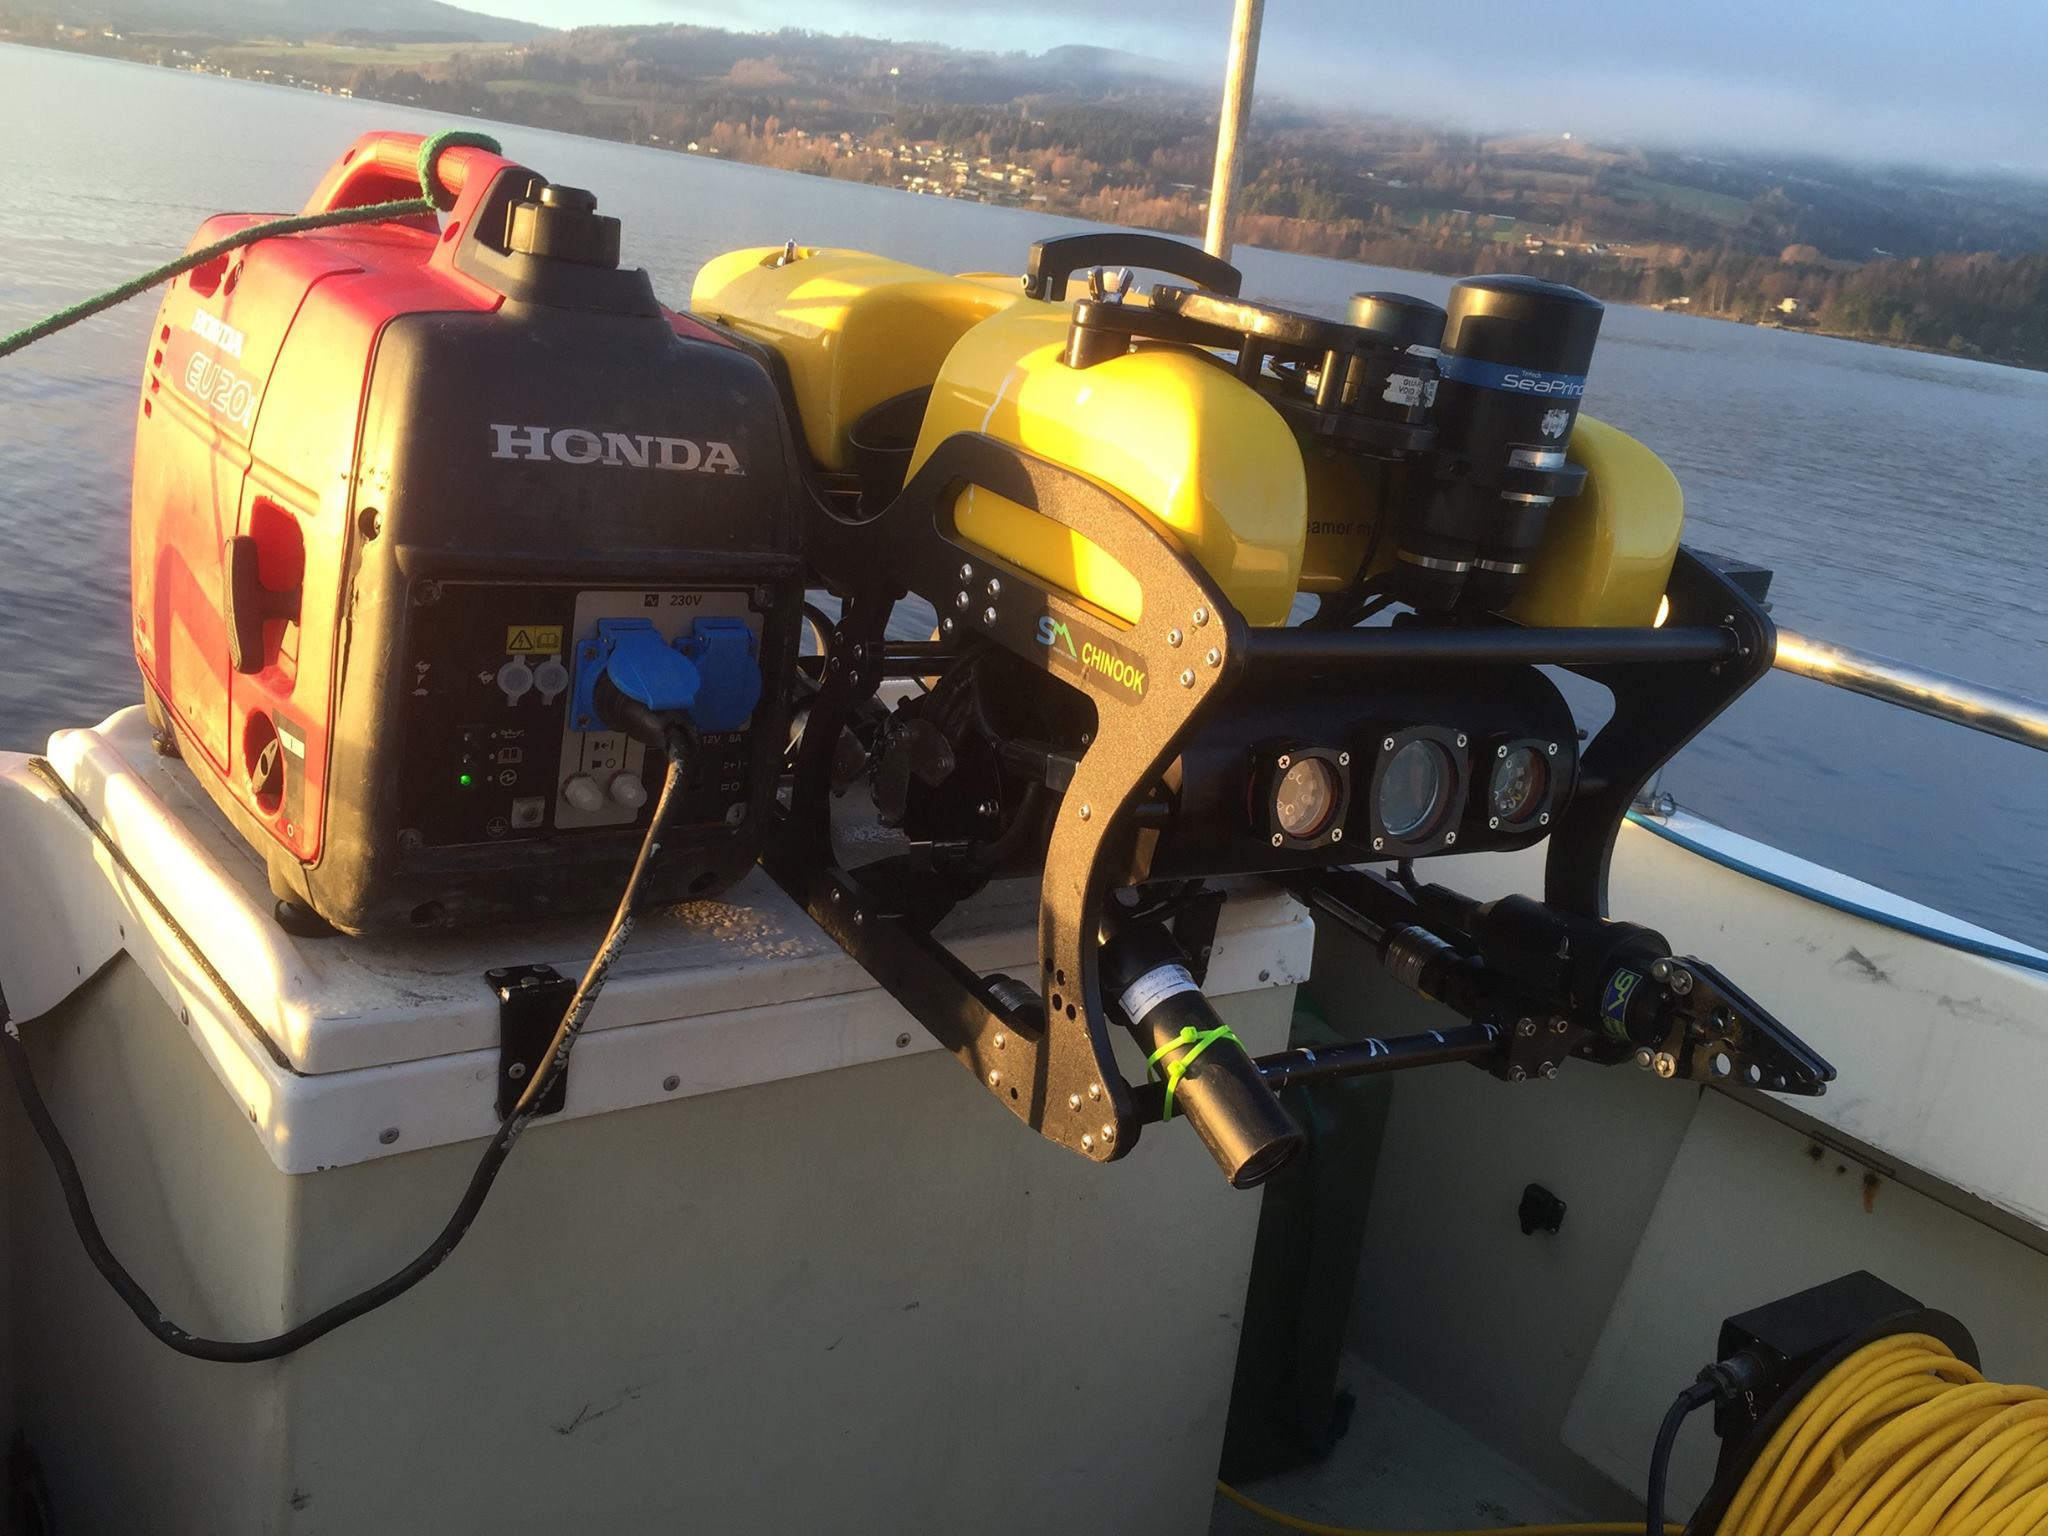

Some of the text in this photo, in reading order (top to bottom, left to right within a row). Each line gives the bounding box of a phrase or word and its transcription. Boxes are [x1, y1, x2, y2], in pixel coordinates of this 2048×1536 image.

[490, 423, 746, 476] HONDA
[670, 594, 703, 607] 230V
[1081, 642, 1146, 695] CHINOOK
[703, 734, 721, 745] 12V
